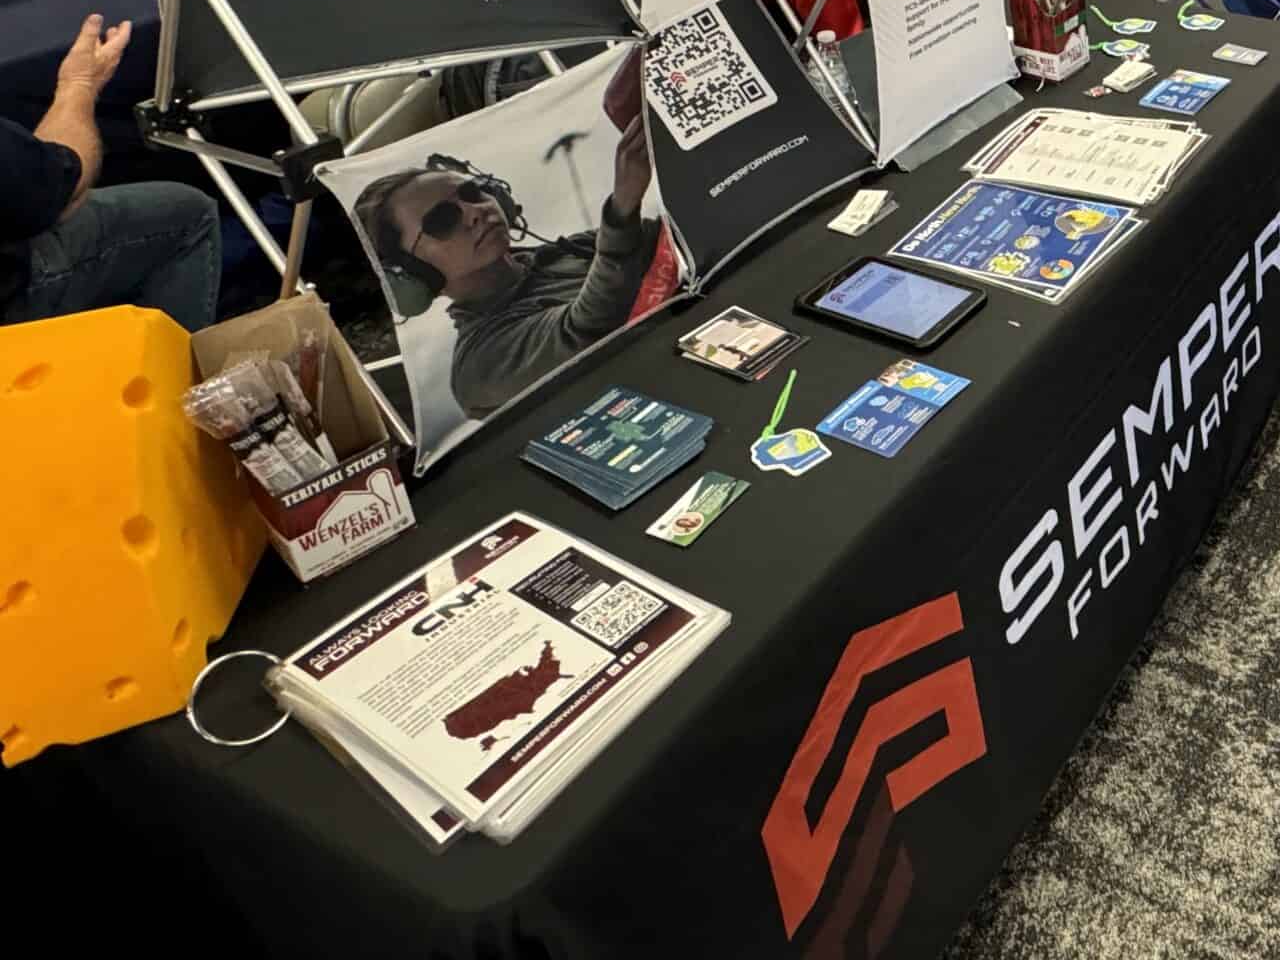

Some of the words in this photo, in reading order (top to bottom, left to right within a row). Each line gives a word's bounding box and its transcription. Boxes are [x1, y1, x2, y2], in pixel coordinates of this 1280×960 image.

[281, 470, 344, 508] TERIYAKI
[345, 447, 388, 477] STICKS
[1066, 325, 1262, 639] FORWARD
[301, 502, 380, 552] WENZEL'S
[341, 515, 385, 546] FARM
[308, 626, 362, 666] ALWAYS
[362, 590, 419, 628] LOOKING
[313, 591, 430, 672] FORWARD
